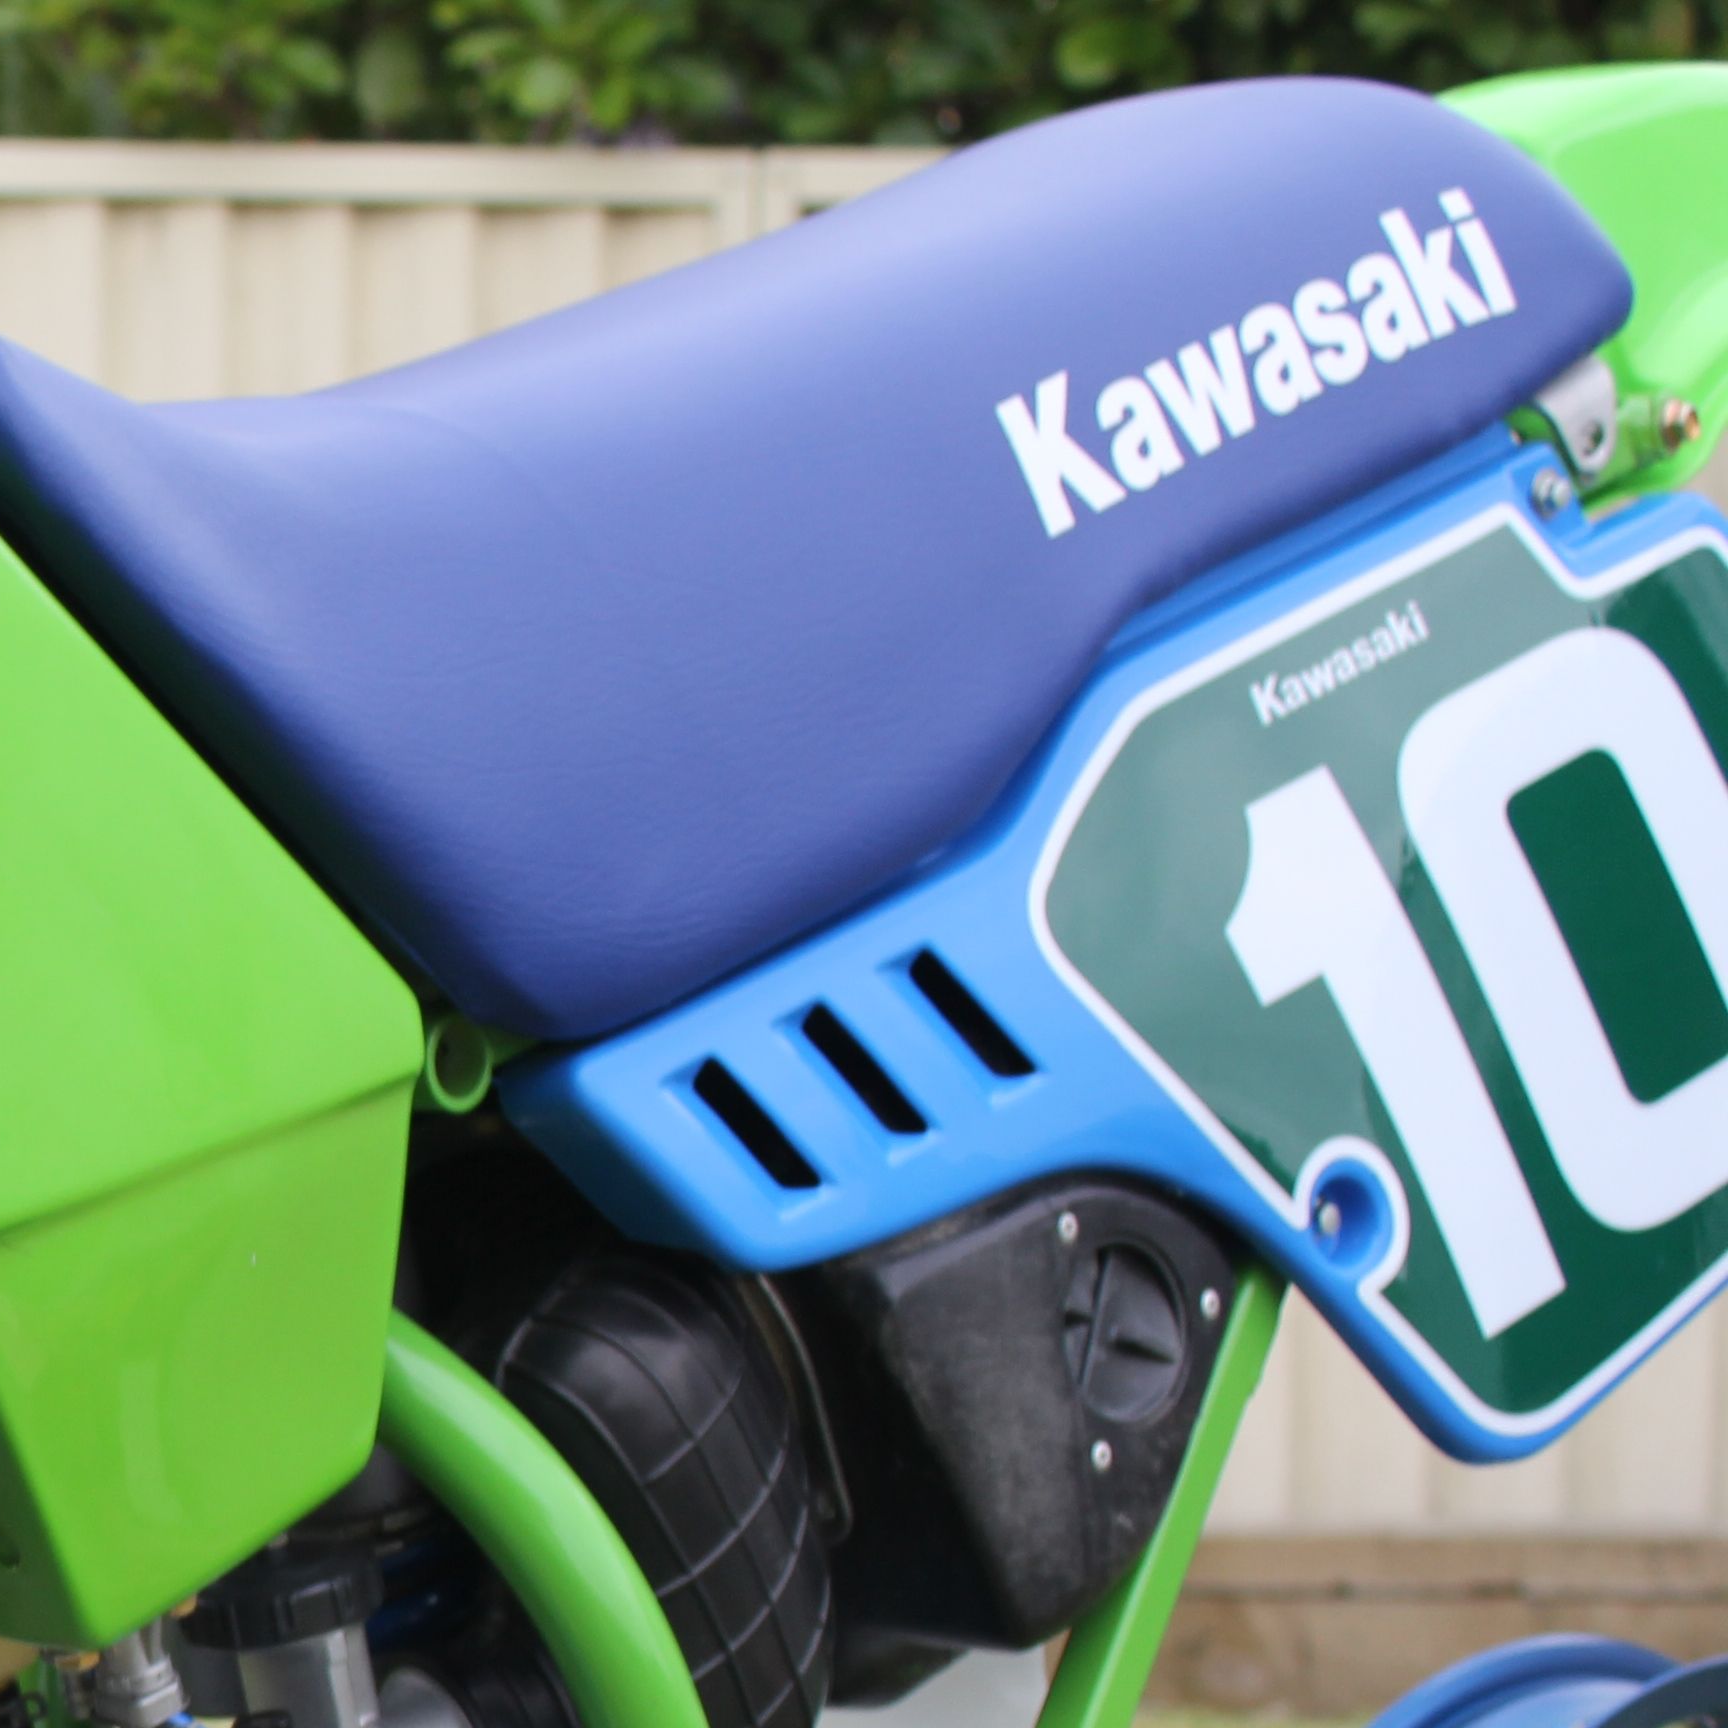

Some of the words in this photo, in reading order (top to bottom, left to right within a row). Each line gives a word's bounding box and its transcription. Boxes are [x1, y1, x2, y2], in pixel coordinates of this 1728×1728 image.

[996, 188, 1517, 538] Kawasaki
[1250, 601, 1429, 727] Kawasaki
[1225, 625, 1728, 1341] 10
